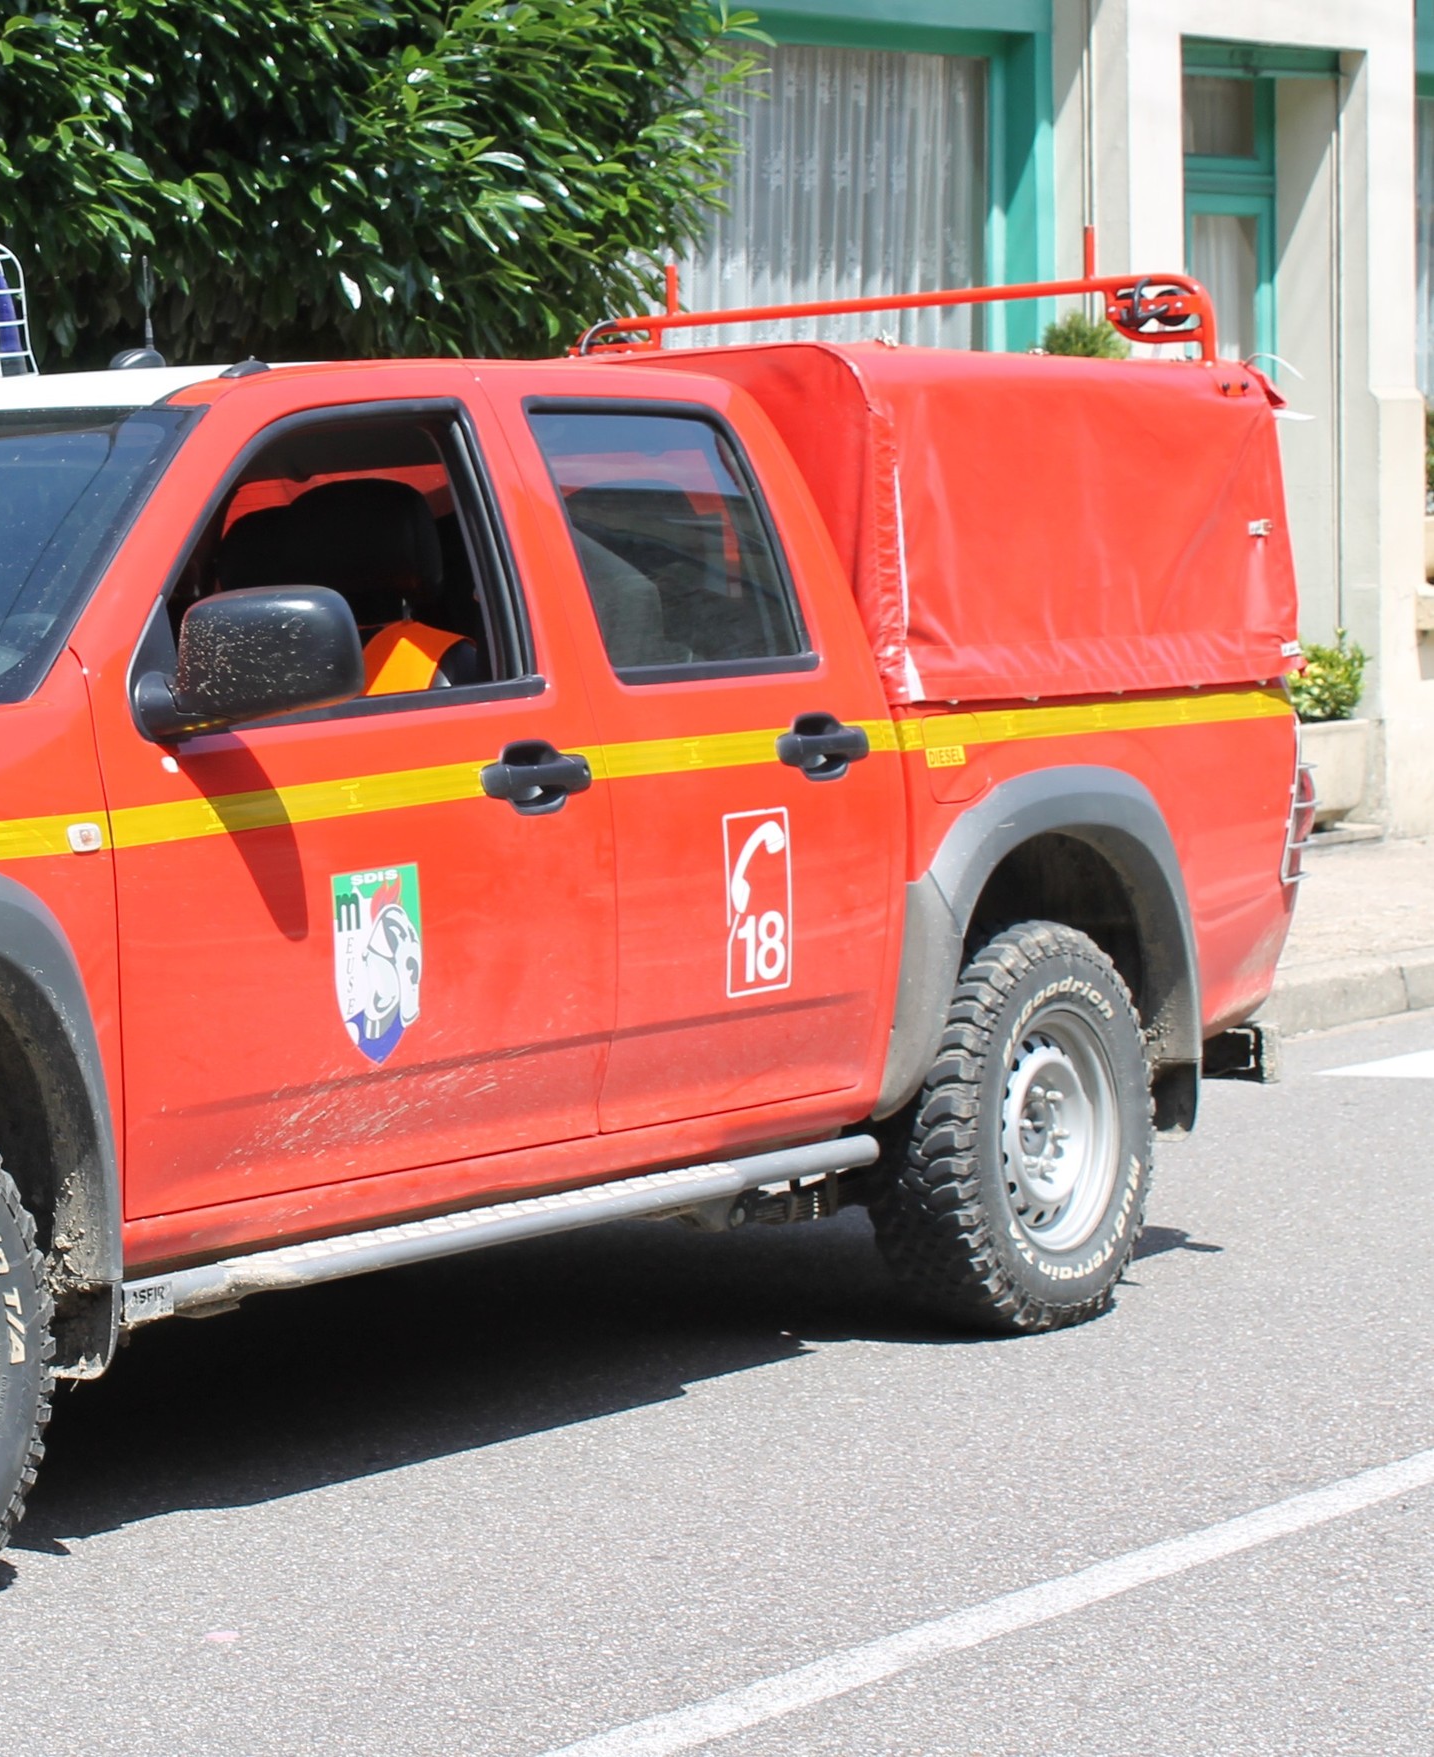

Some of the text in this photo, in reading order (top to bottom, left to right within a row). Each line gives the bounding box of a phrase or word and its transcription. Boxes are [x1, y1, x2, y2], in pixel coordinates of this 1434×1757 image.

[928, 748, 964, 765] DIESEL
[350, 869, 398, 887] SDIS
[737, 910, 786, 983] 18
[2, 1287, 26, 1365] T/A
